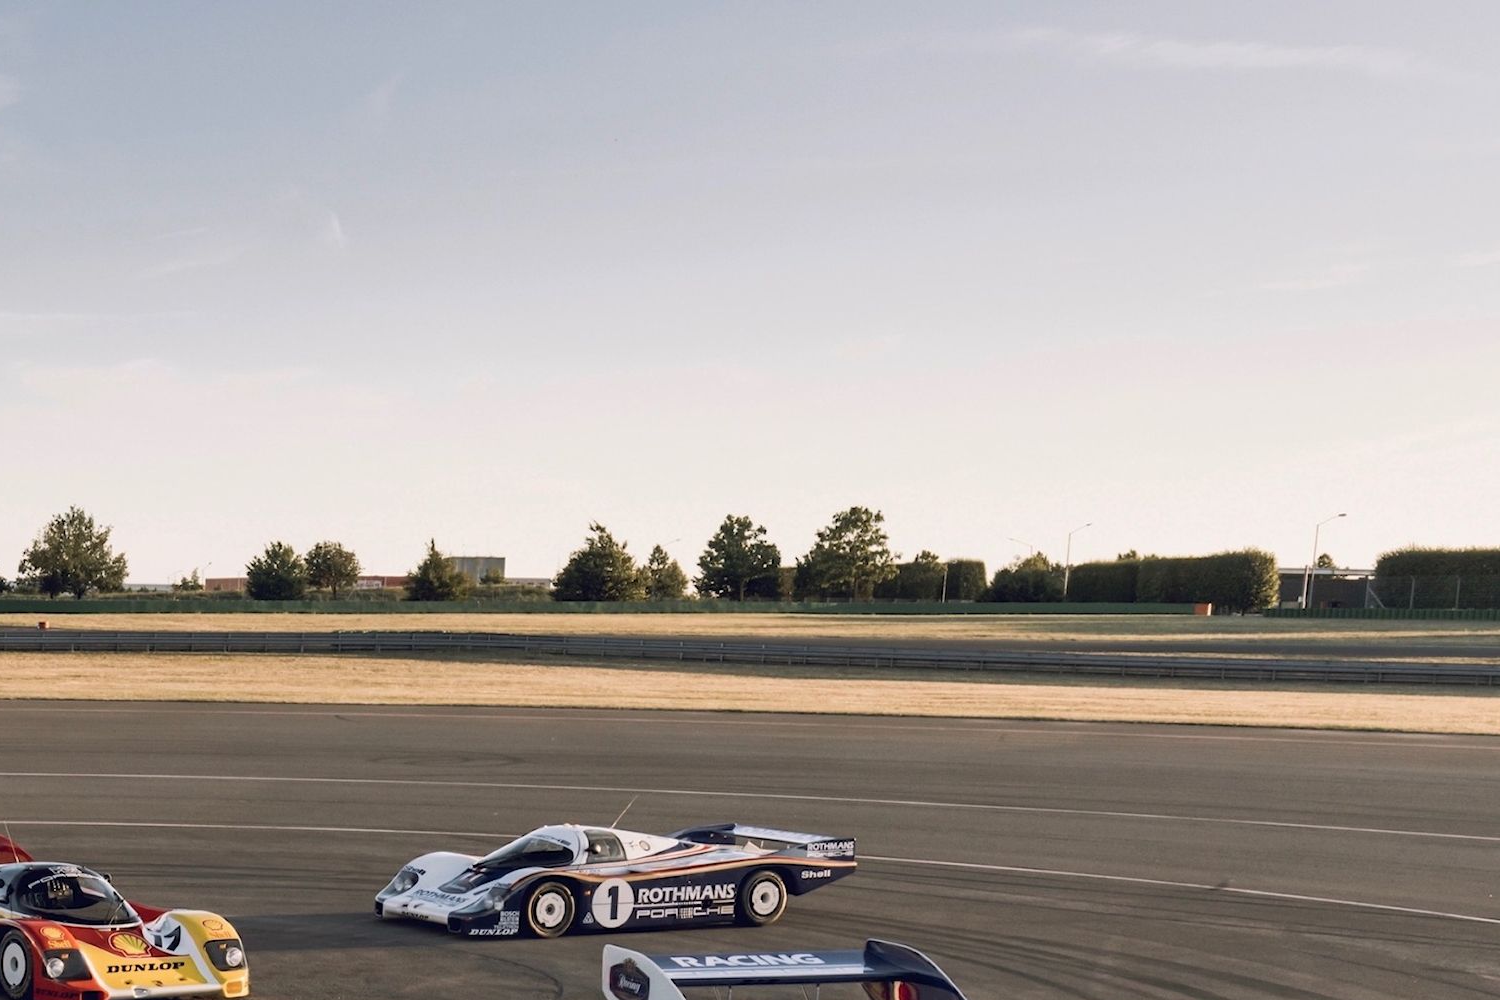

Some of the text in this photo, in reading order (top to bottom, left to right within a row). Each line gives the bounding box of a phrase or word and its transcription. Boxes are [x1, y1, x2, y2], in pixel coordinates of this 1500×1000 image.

[807, 841, 854, 851] ROTHMANS
[801, 869, 831, 879] Shell
[638, 883, 736, 904] ROTHMANS
[608, 886, 619, 920] 1
[106, 961, 185, 973] DUNLOP
[671, 953, 825, 968] RACING
